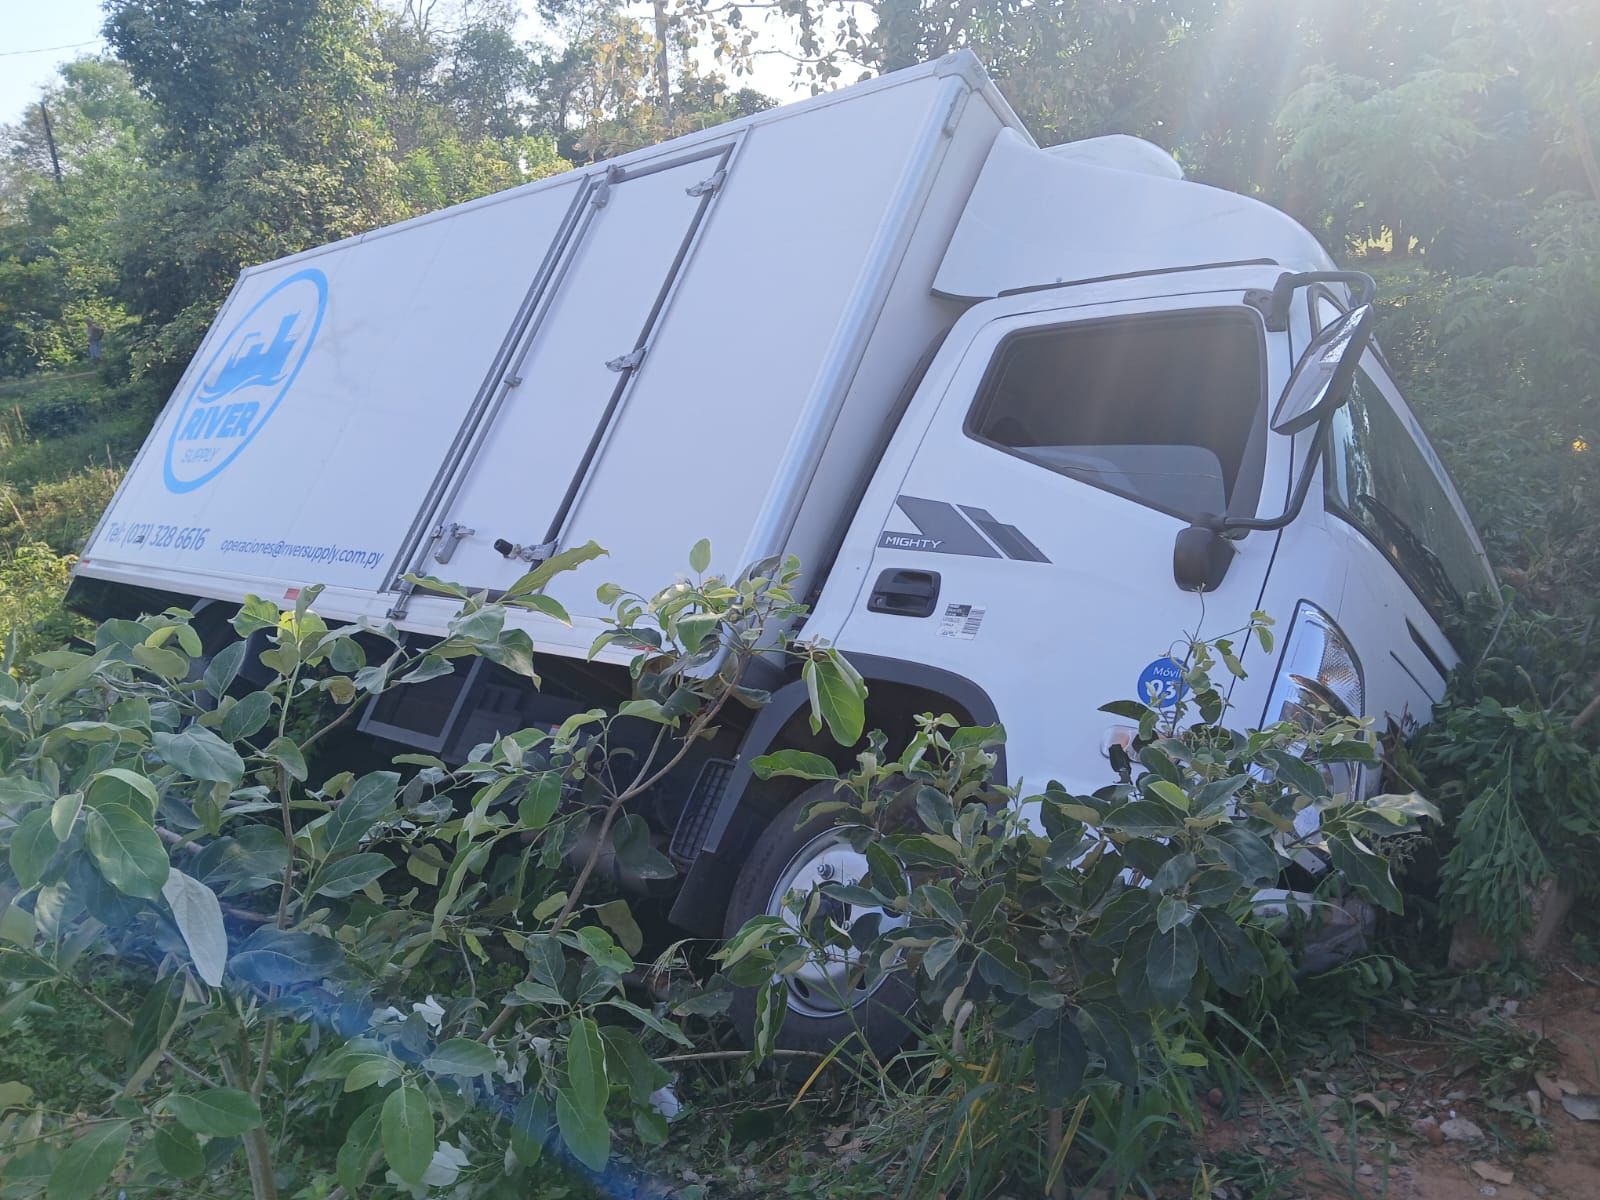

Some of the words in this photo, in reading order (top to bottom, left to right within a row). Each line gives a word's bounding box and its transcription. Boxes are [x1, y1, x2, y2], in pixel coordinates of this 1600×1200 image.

[179, 401, 260, 440] RIVER
[149, 525, 178, 547] 328
[174, 527, 211, 551] 6616
[885, 536, 943, 549] MIGHTY
[220, 538, 384, 569] operaciones@riversupply.com.py
[1152, 666, 1183, 679] Móvil
